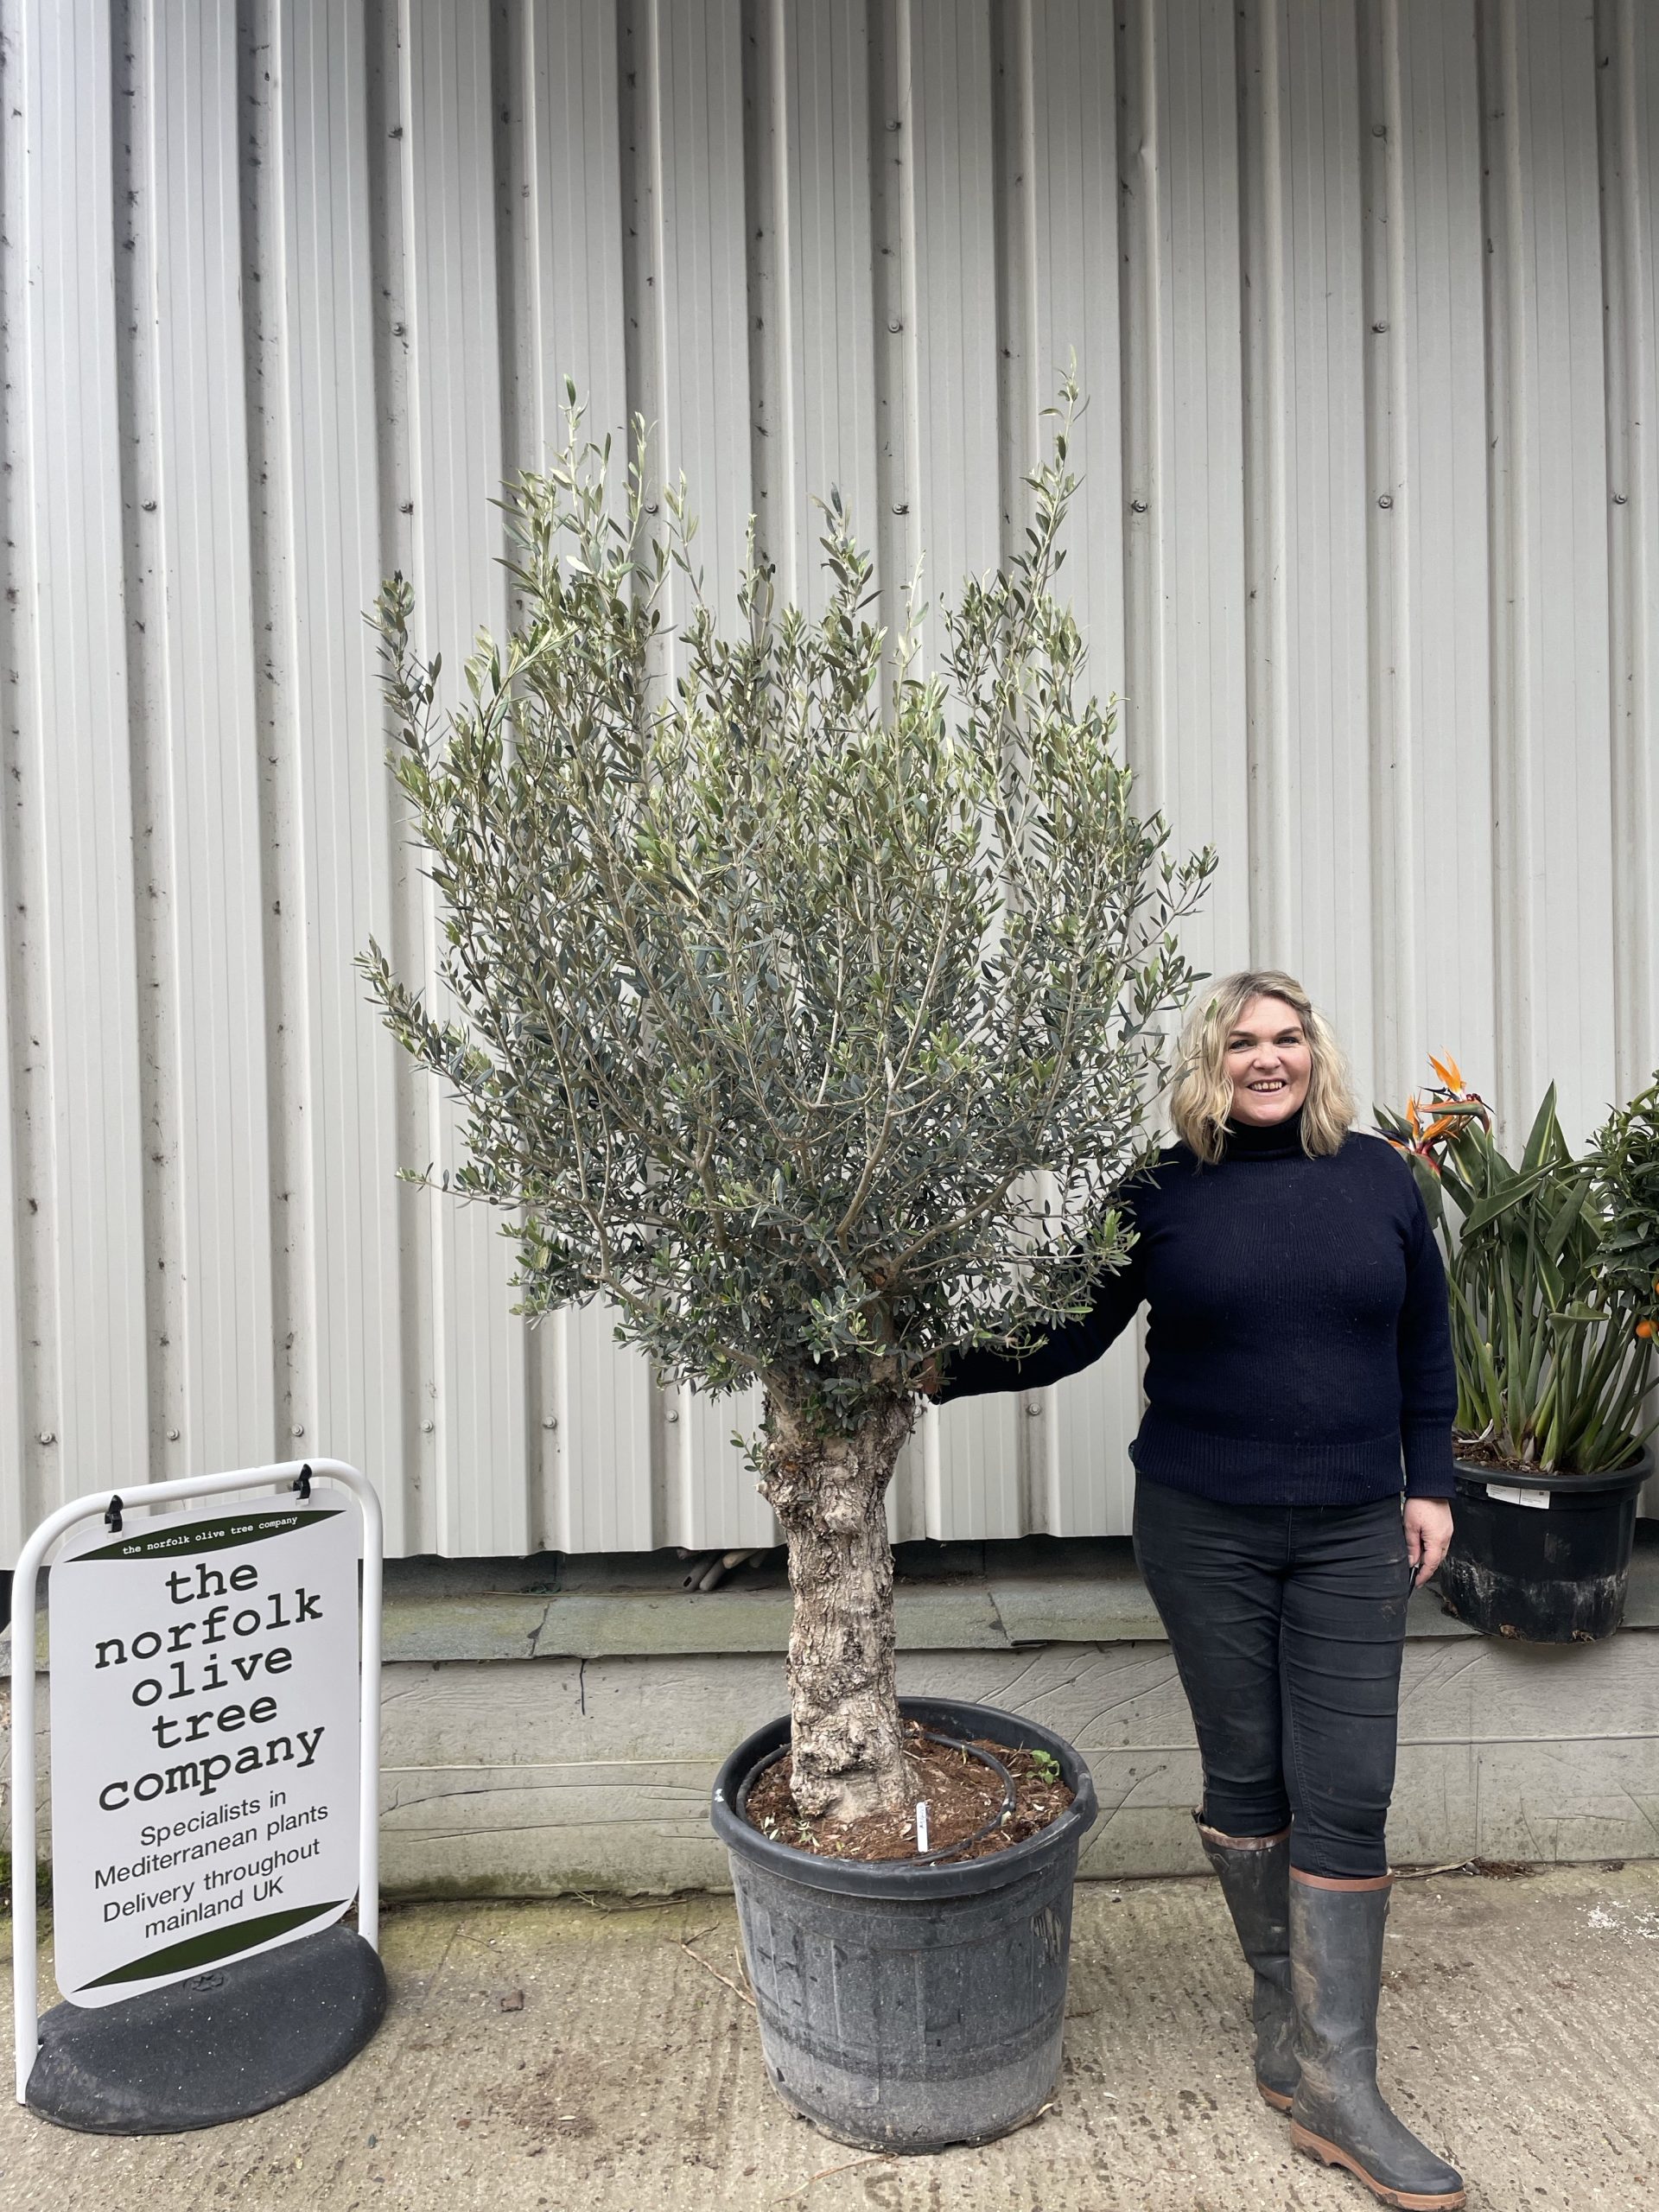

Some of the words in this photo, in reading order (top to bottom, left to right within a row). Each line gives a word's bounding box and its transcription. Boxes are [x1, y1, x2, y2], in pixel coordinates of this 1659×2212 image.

[123, 1544, 142, 1555] the
[146, 1535, 191, 1551] norfolk
[194, 1529, 226, 1542] olive
[230, 1523, 254, 1535] tree
[258, 1516, 298, 1531] company
[164, 1562, 258, 1605] the
[94, 1587, 323, 1669] norfolk
[131, 1647, 292, 1707] olive
[151, 1696, 277, 1749] tree
[99, 1726, 326, 1811] company
[94, 1827, 258, 1891] Mediterranean
[266, 1805, 328, 1841] plants
[140, 1799, 261, 1847] Specialists
[270, 1789, 287, 1808] in
[104, 1881, 195, 1923] Delivery
[203, 1838, 321, 1891] throughout
[144, 1889, 244, 1939] mainland
[253, 1875, 284, 1902] UK
